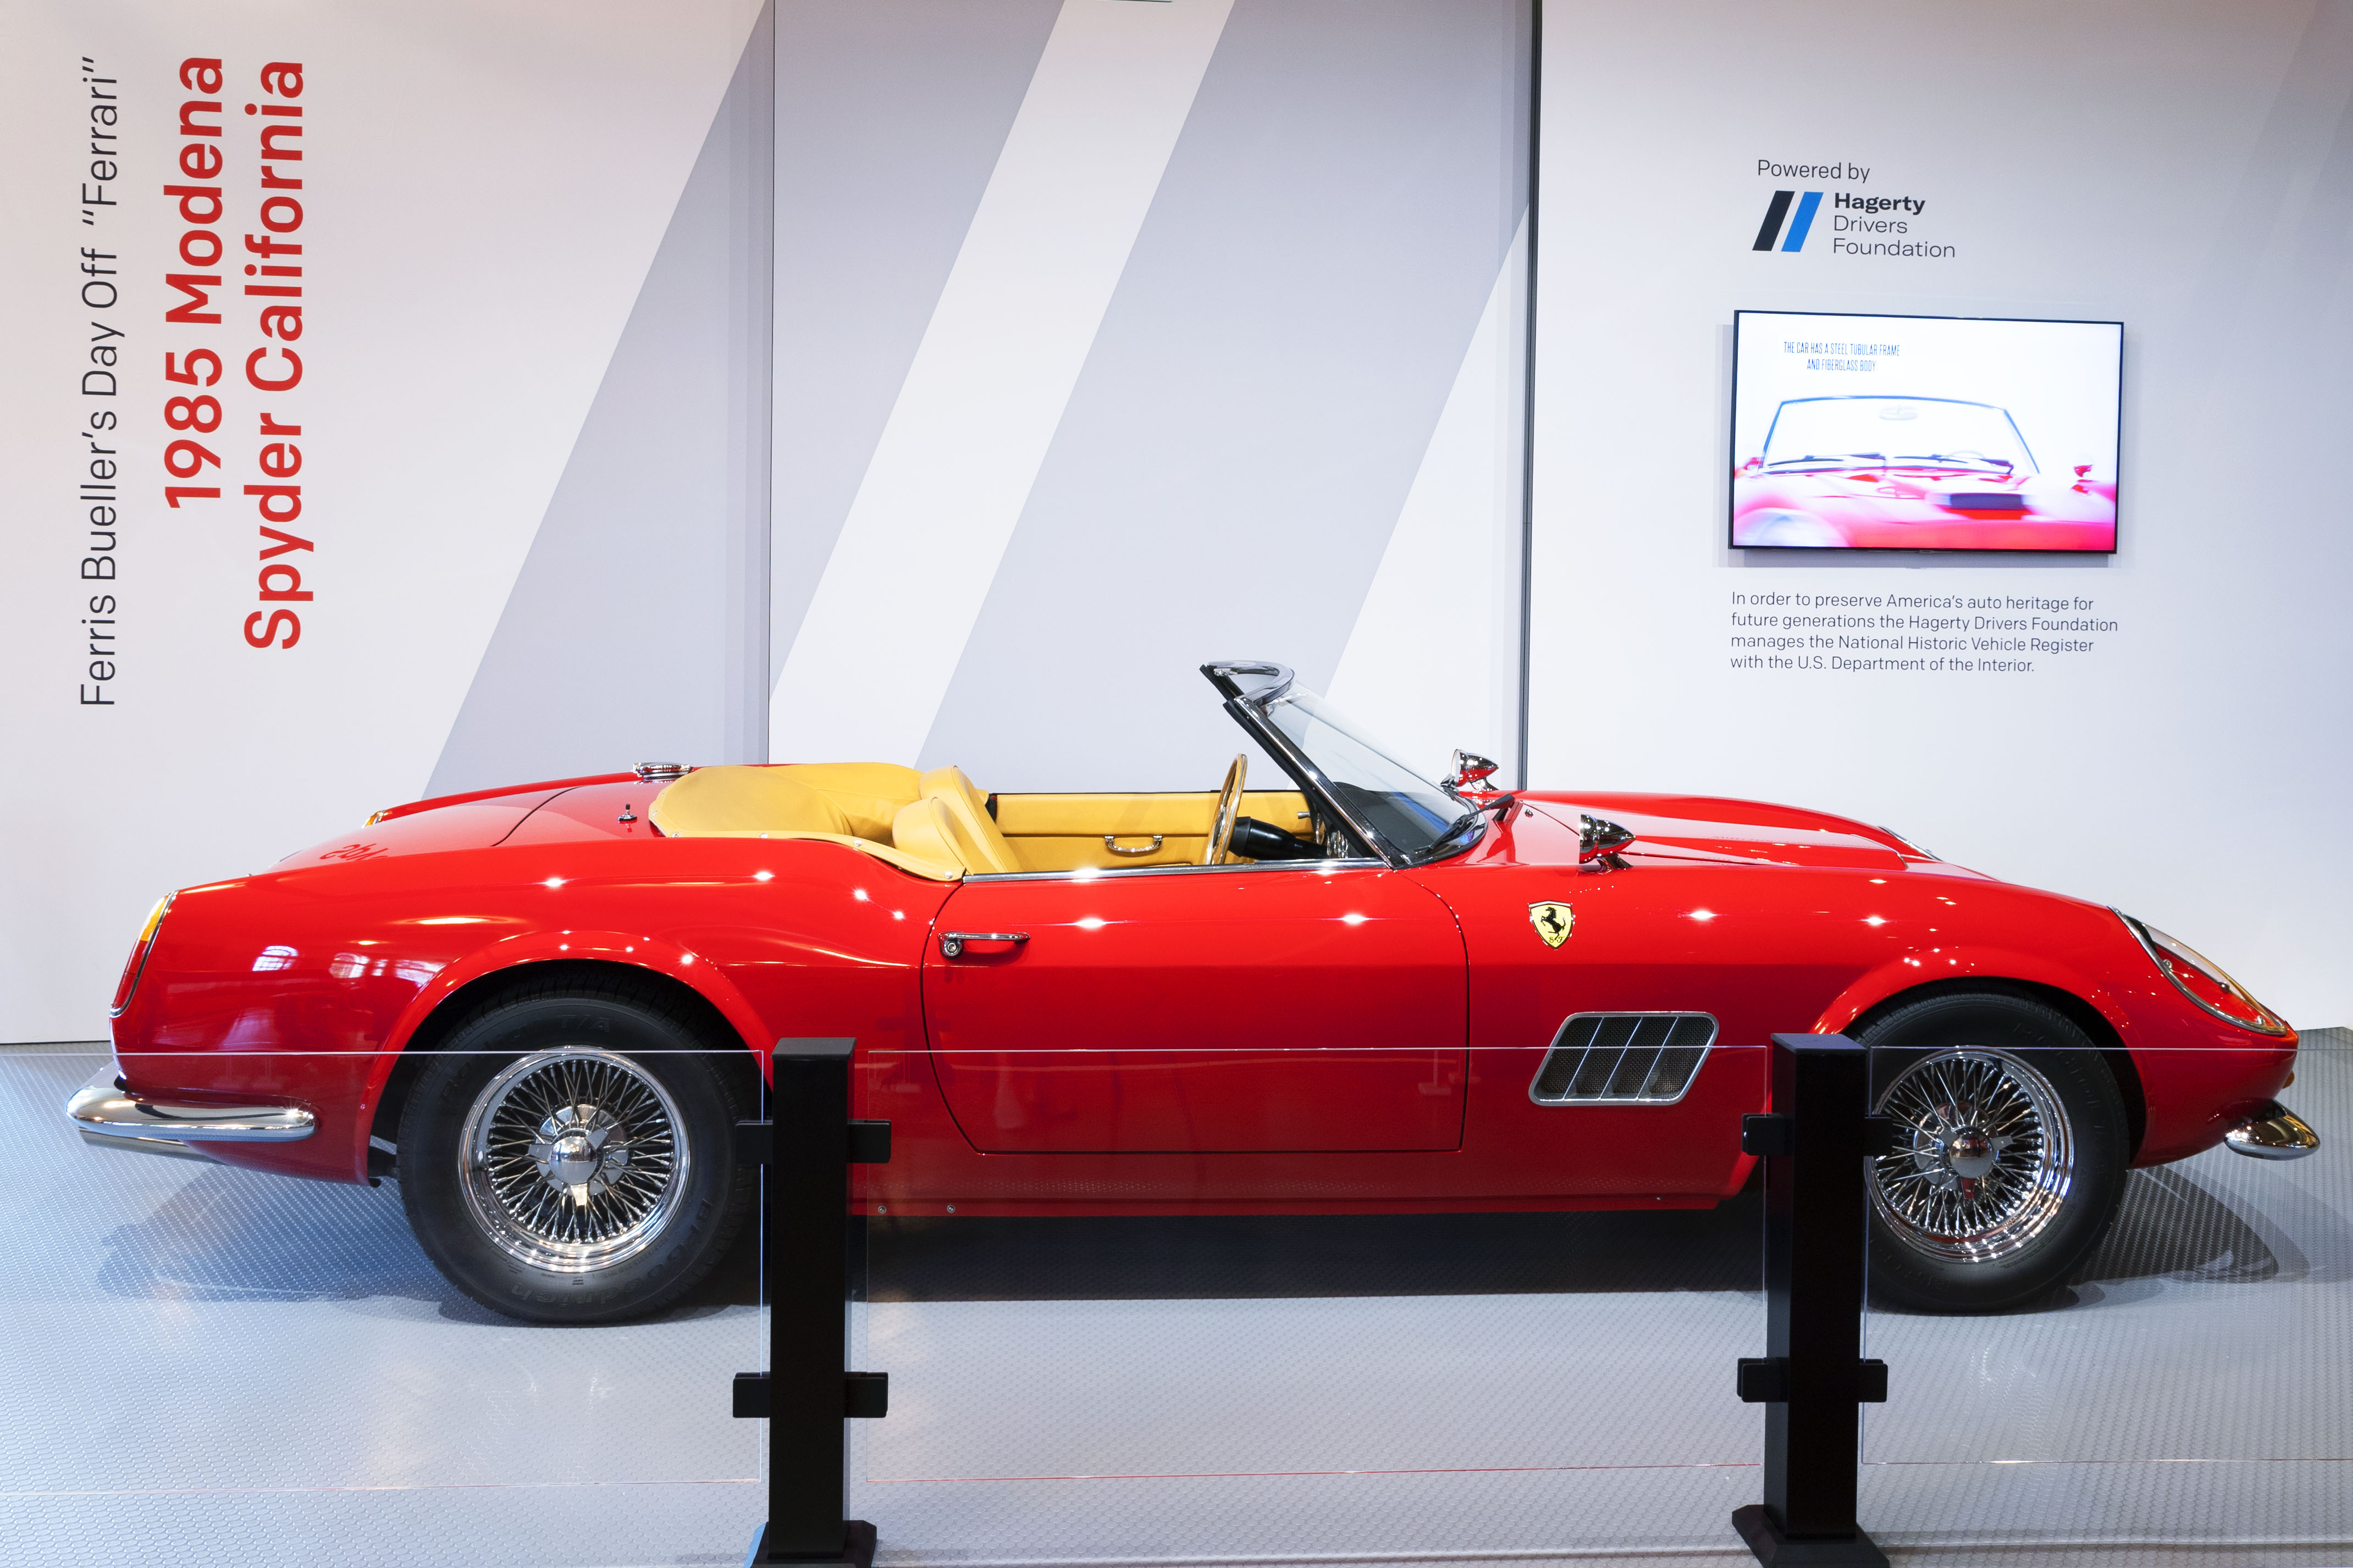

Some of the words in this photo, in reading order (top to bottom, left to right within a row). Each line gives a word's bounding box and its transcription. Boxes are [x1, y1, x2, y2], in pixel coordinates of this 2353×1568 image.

[1758, 159, 1841, 179] Powered
[1848, 163, 1870, 184] by
[164, 58, 223, 324] Modena
[1835, 193, 1925, 215] Hagerty
[244, 62, 303, 391] California
[1835, 215, 1907, 234] Drivers
[1834, 237, 1954, 257] Foundation
[81, 247, 117, 308] Off
[82, 322, 125, 396] Day
[1784, 342, 1794, 353] THE
[1797, 342, 1808, 353] CAR
[1811, 343, 1822, 353] HAS
[1825, 343, 1828, 354] A
[1831, 343, 1847, 354] STEEL
[1851, 344, 1877, 355] TUBULAR
[1880, 345, 1899, 356] FRAME
[1807, 359, 1819, 369] AND
[1822, 359, 1858, 371] FIBERGLASS
[1860, 361, 1875, 372] BODY
[164, 348, 222, 508] 1985
[80, 411, 117, 579] Bueller's
[244, 413, 313, 649] Spyder
[1733, 591, 1745, 605] In
[1750, 592, 1791, 606] order
[1796, 593, 1810, 606] to
[1816, 595, 1881, 608] preserve
[1887, 594, 1963, 608] America's
[1968, 596, 2001, 608] auto
[2007, 596, 2069, 612] heritage
[2074, 597, 2094, 610] for
[1732, 612, 1777, 626] future
[1783, 614, 1875, 629] generations
[1880, 614, 1904, 628] the
[1910, 616, 1970, 631] Hagerty
[1975, 617, 2027, 630] Drivers
[2032, 617, 2117, 631] Foundation
[81, 595, 115, 705] Ferris
[1732, 637, 1804, 650] manages
[1809, 635, 1833, 648] the
[1840, 635, 1903, 649] National
[1909, 636, 1967, 650] Historic
[1971, 637, 2025, 651] Vehicle
[2031, 638, 2094, 654] Register
[1731, 655, 1763, 668] with
[1768, 655, 1793, 668] the
[1799, 656, 1826, 669] U.S.
[1832, 656, 1925, 672] Department
[1930, 657, 1945, 671] of
[1949, 657, 1973, 671] the
[1979, 658, 2034, 672] Interior.
